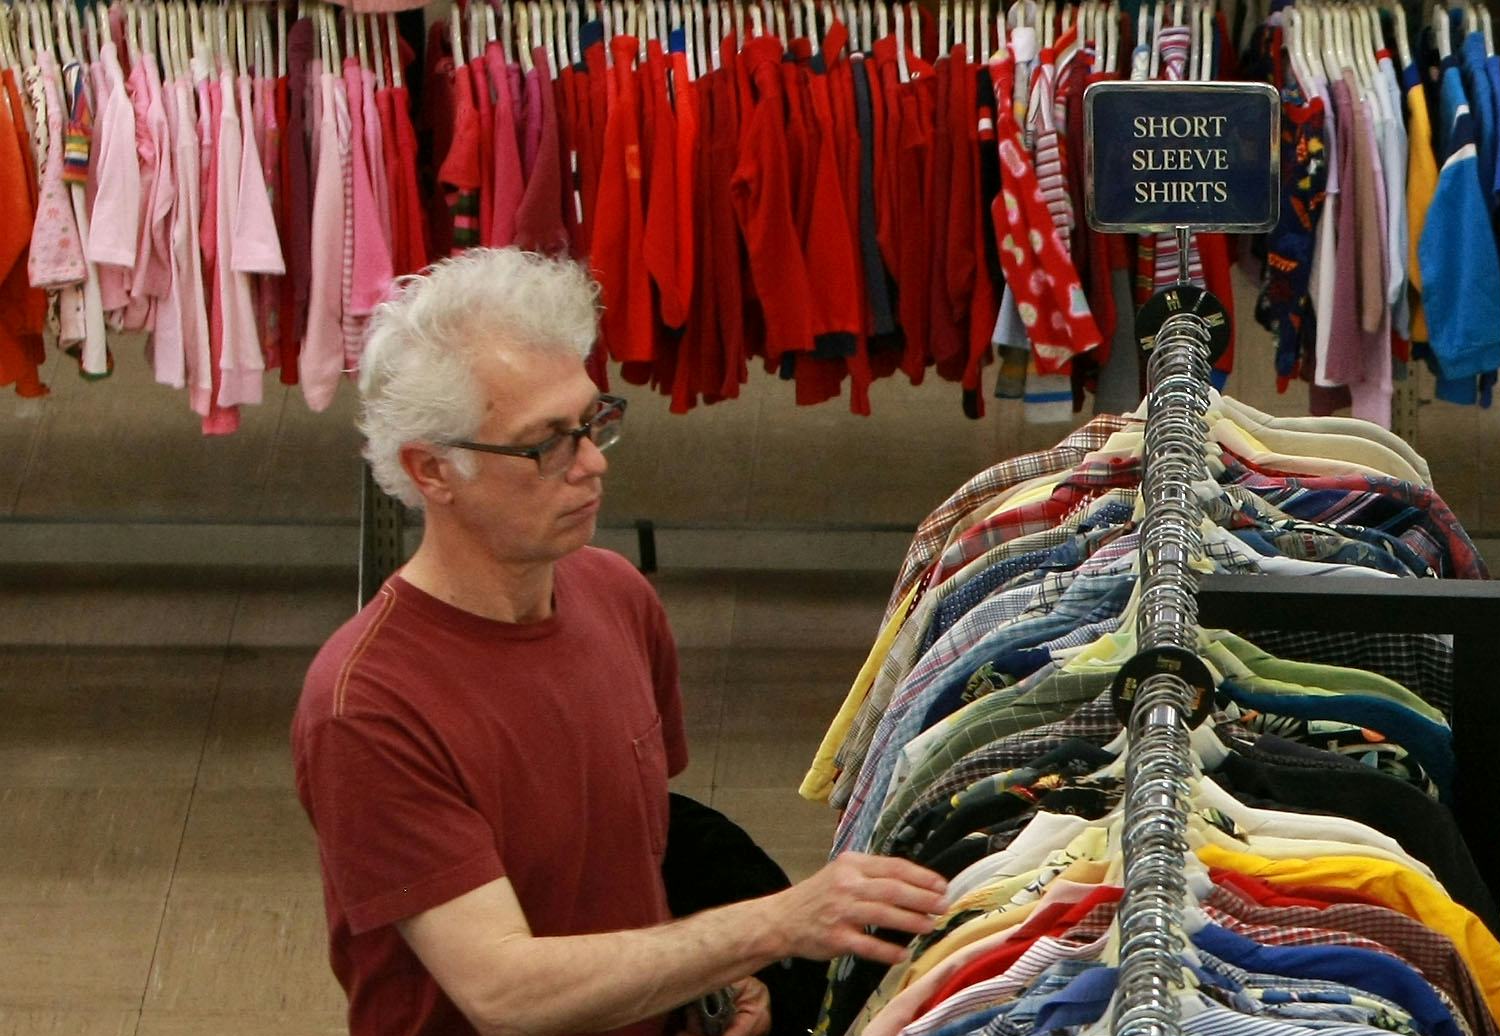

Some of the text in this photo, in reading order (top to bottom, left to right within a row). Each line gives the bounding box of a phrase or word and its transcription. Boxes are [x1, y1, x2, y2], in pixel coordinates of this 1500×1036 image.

[1133, 116, 1227, 138] SHORT
[1132, 149, 1229, 171] SLEEVE
[1135, 181, 1228, 203] SHIRTS
